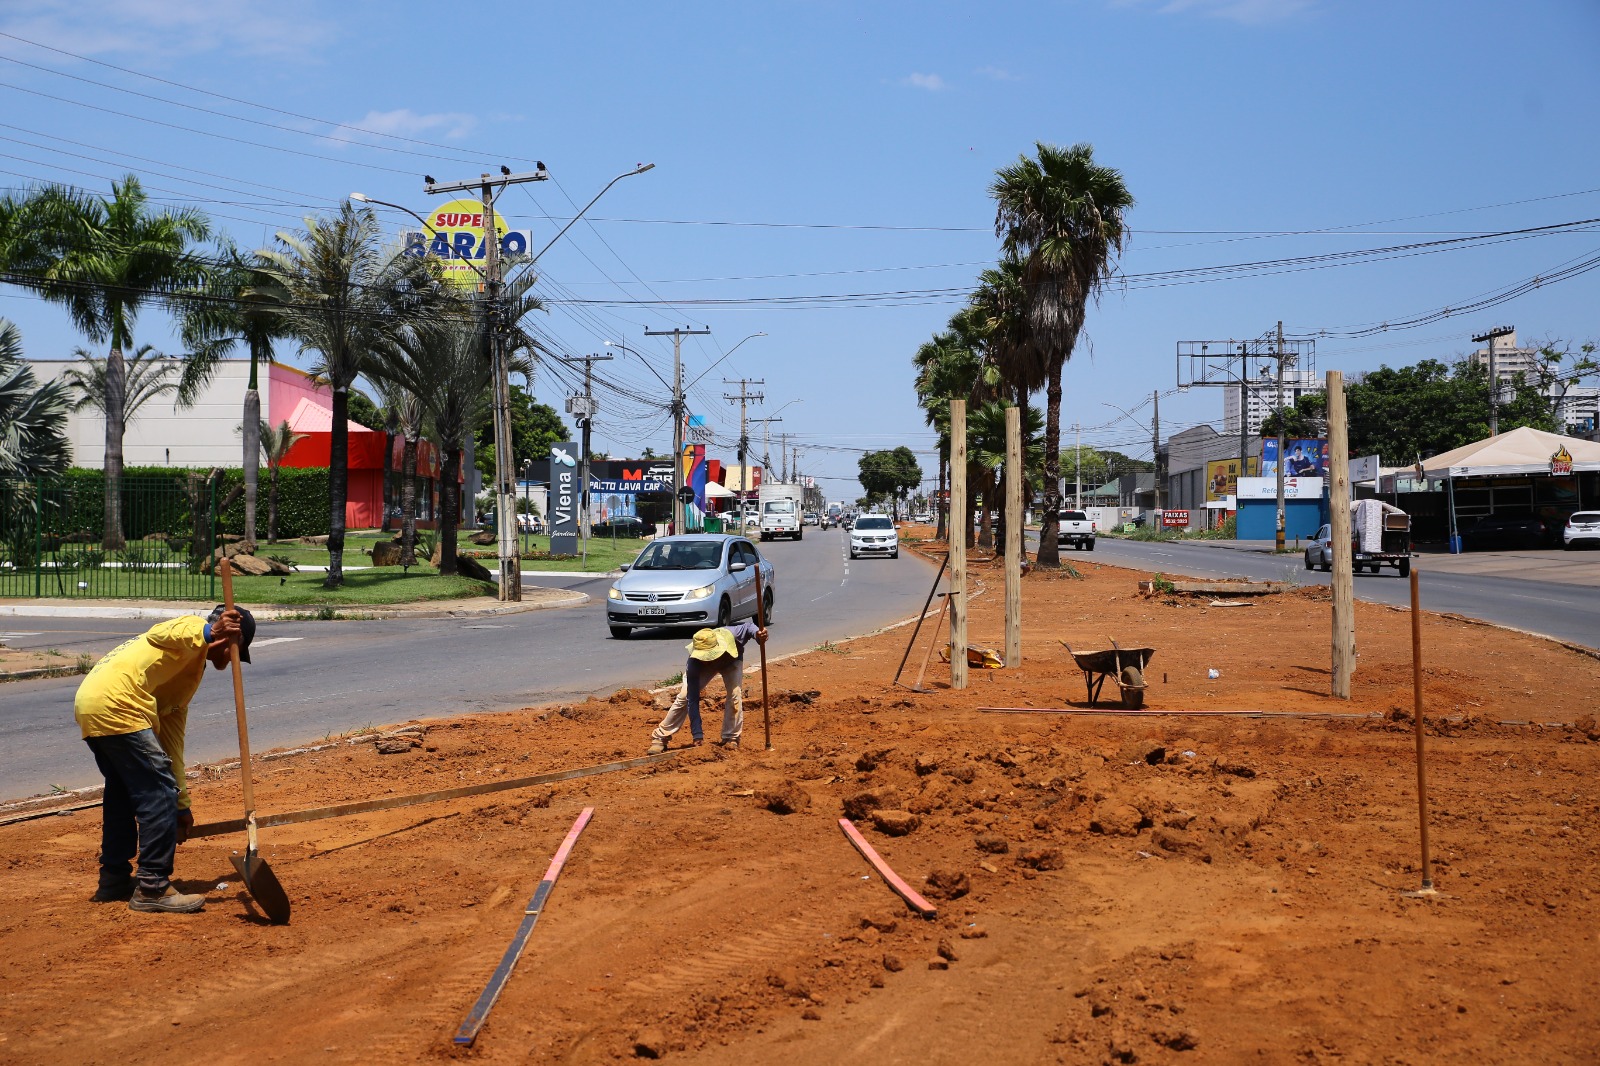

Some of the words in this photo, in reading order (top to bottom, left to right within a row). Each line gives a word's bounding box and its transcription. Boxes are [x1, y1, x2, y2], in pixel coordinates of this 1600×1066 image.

[435, 213, 485, 227] SUPE
[619, 482, 641, 491] LAVA
[643, 482, 660, 491] CAR
[555, 472, 571, 525] Viena
[551, 530, 576, 538] Jardins
